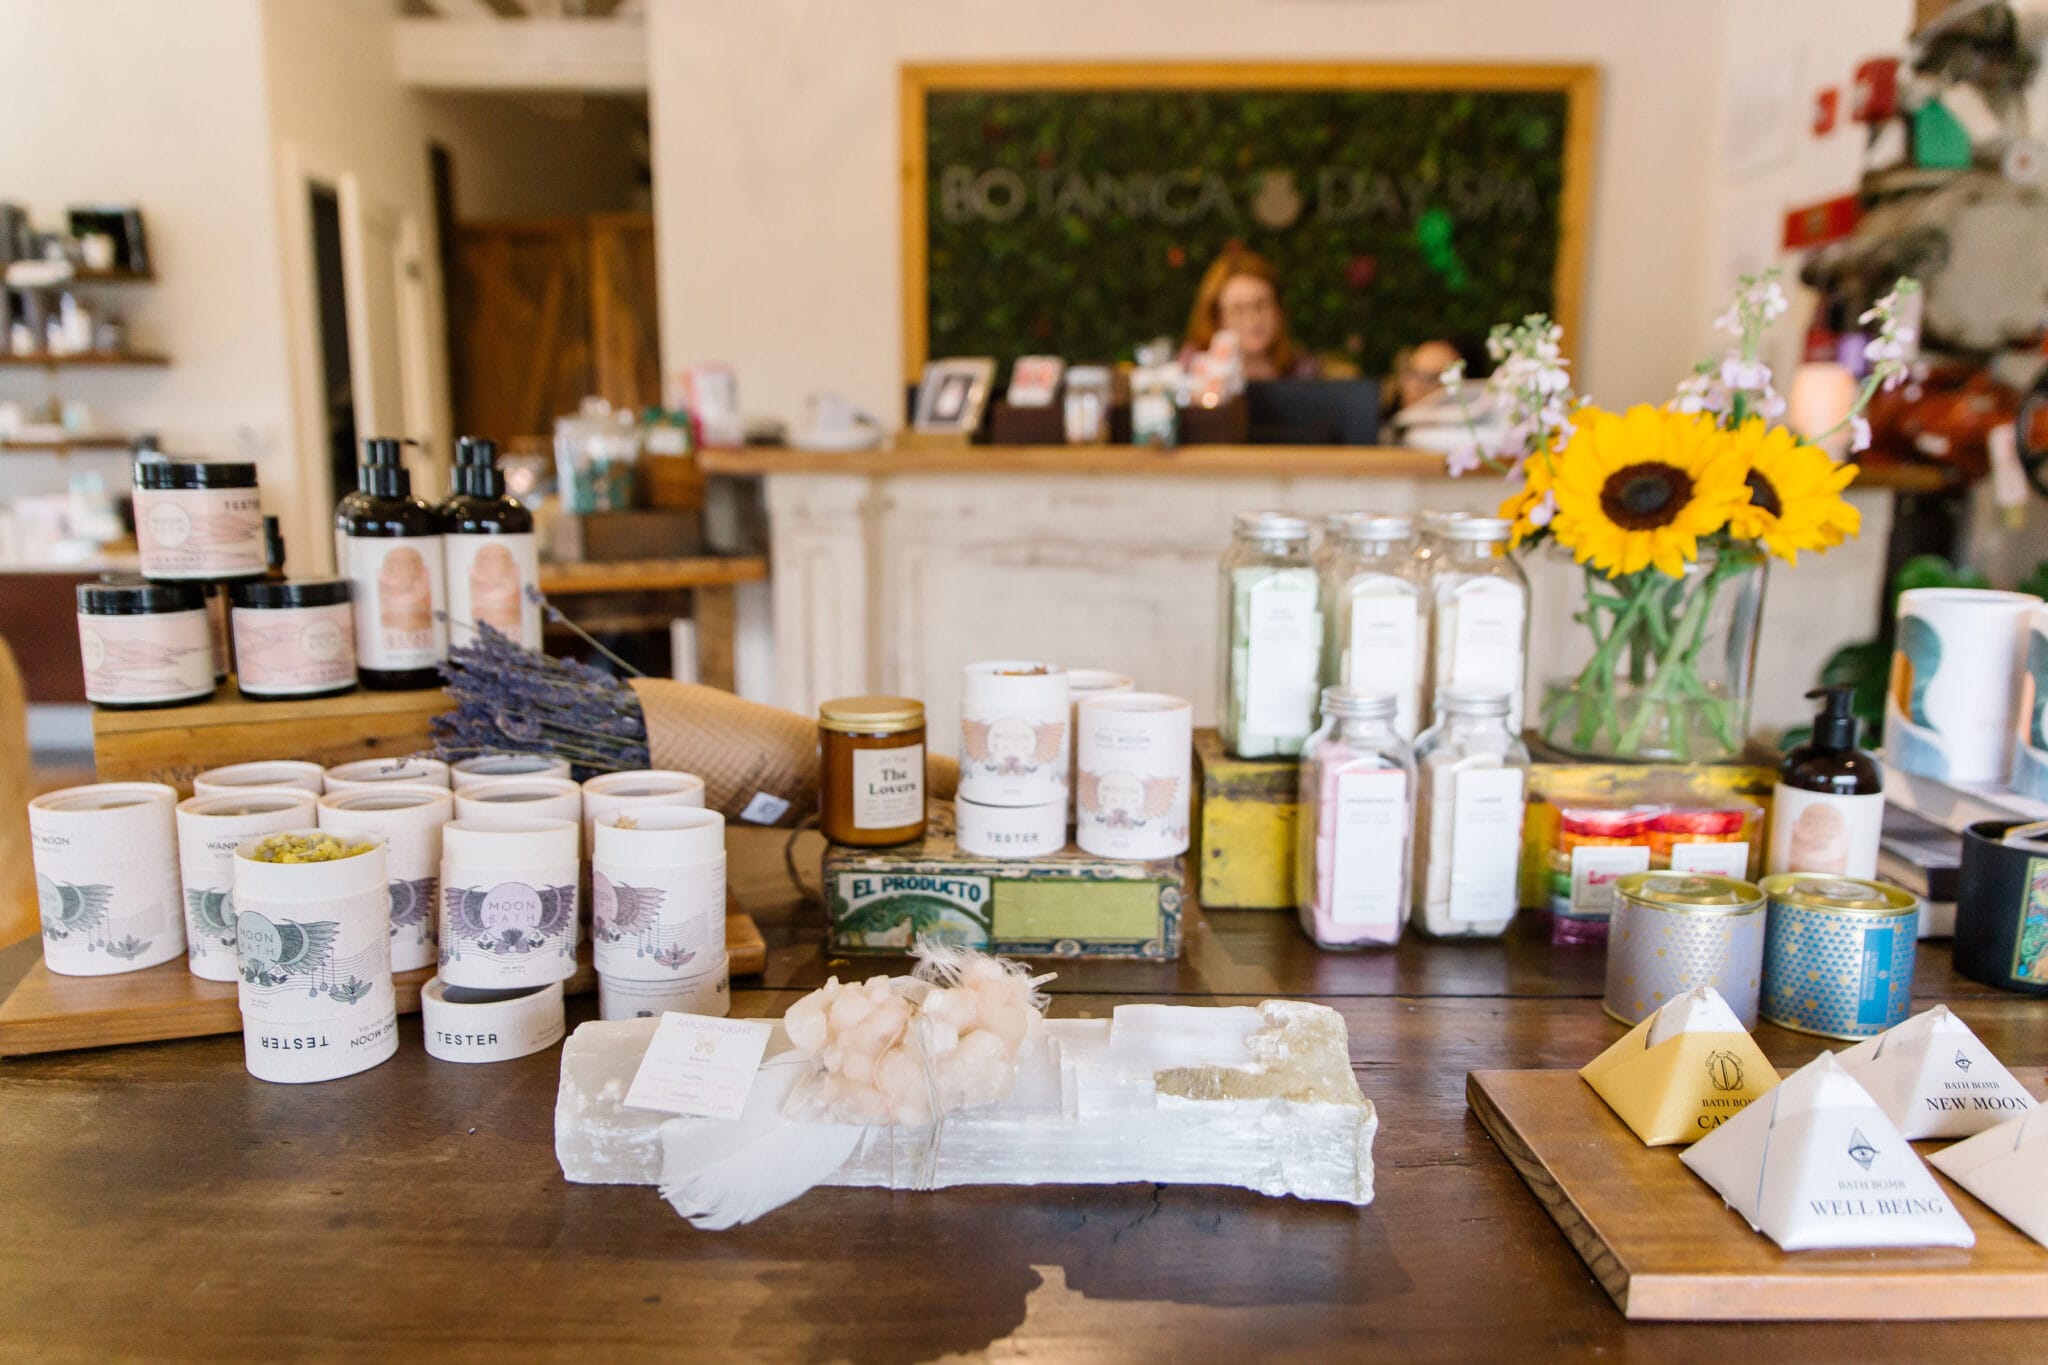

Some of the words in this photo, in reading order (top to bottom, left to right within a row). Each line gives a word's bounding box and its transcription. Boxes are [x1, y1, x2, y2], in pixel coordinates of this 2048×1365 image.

[881, 768, 907, 781] The
[869, 782, 916, 795] Lovers
[986, 832, 1039, 843] TESTER
[853, 878, 876, 899] EL
[881, 876, 981, 902] PRODUCTO
[488, 901, 536, 911] MOON
[488, 914, 536, 924] BATH
[261, 1035, 329, 1049] TESTER
[350, 1028, 382, 1048] MOON
[436, 1031, 498, 1045] TESTER
[1943, 1081, 1969, 1090] BATH
[1972, 1081, 2000, 1089] BOMB
[1702, 1099, 1730, 1107] BATH
[1926, 1096, 1967, 1111] NEW
[1973, 1096, 2028, 1111] MOON
[1837, 1179, 1869, 1190] BATH
[1871, 1179, 1906, 1190] BOMB
[1810, 1199, 1873, 1217] WELL
[1878, 1198, 1943, 1215] BEING
